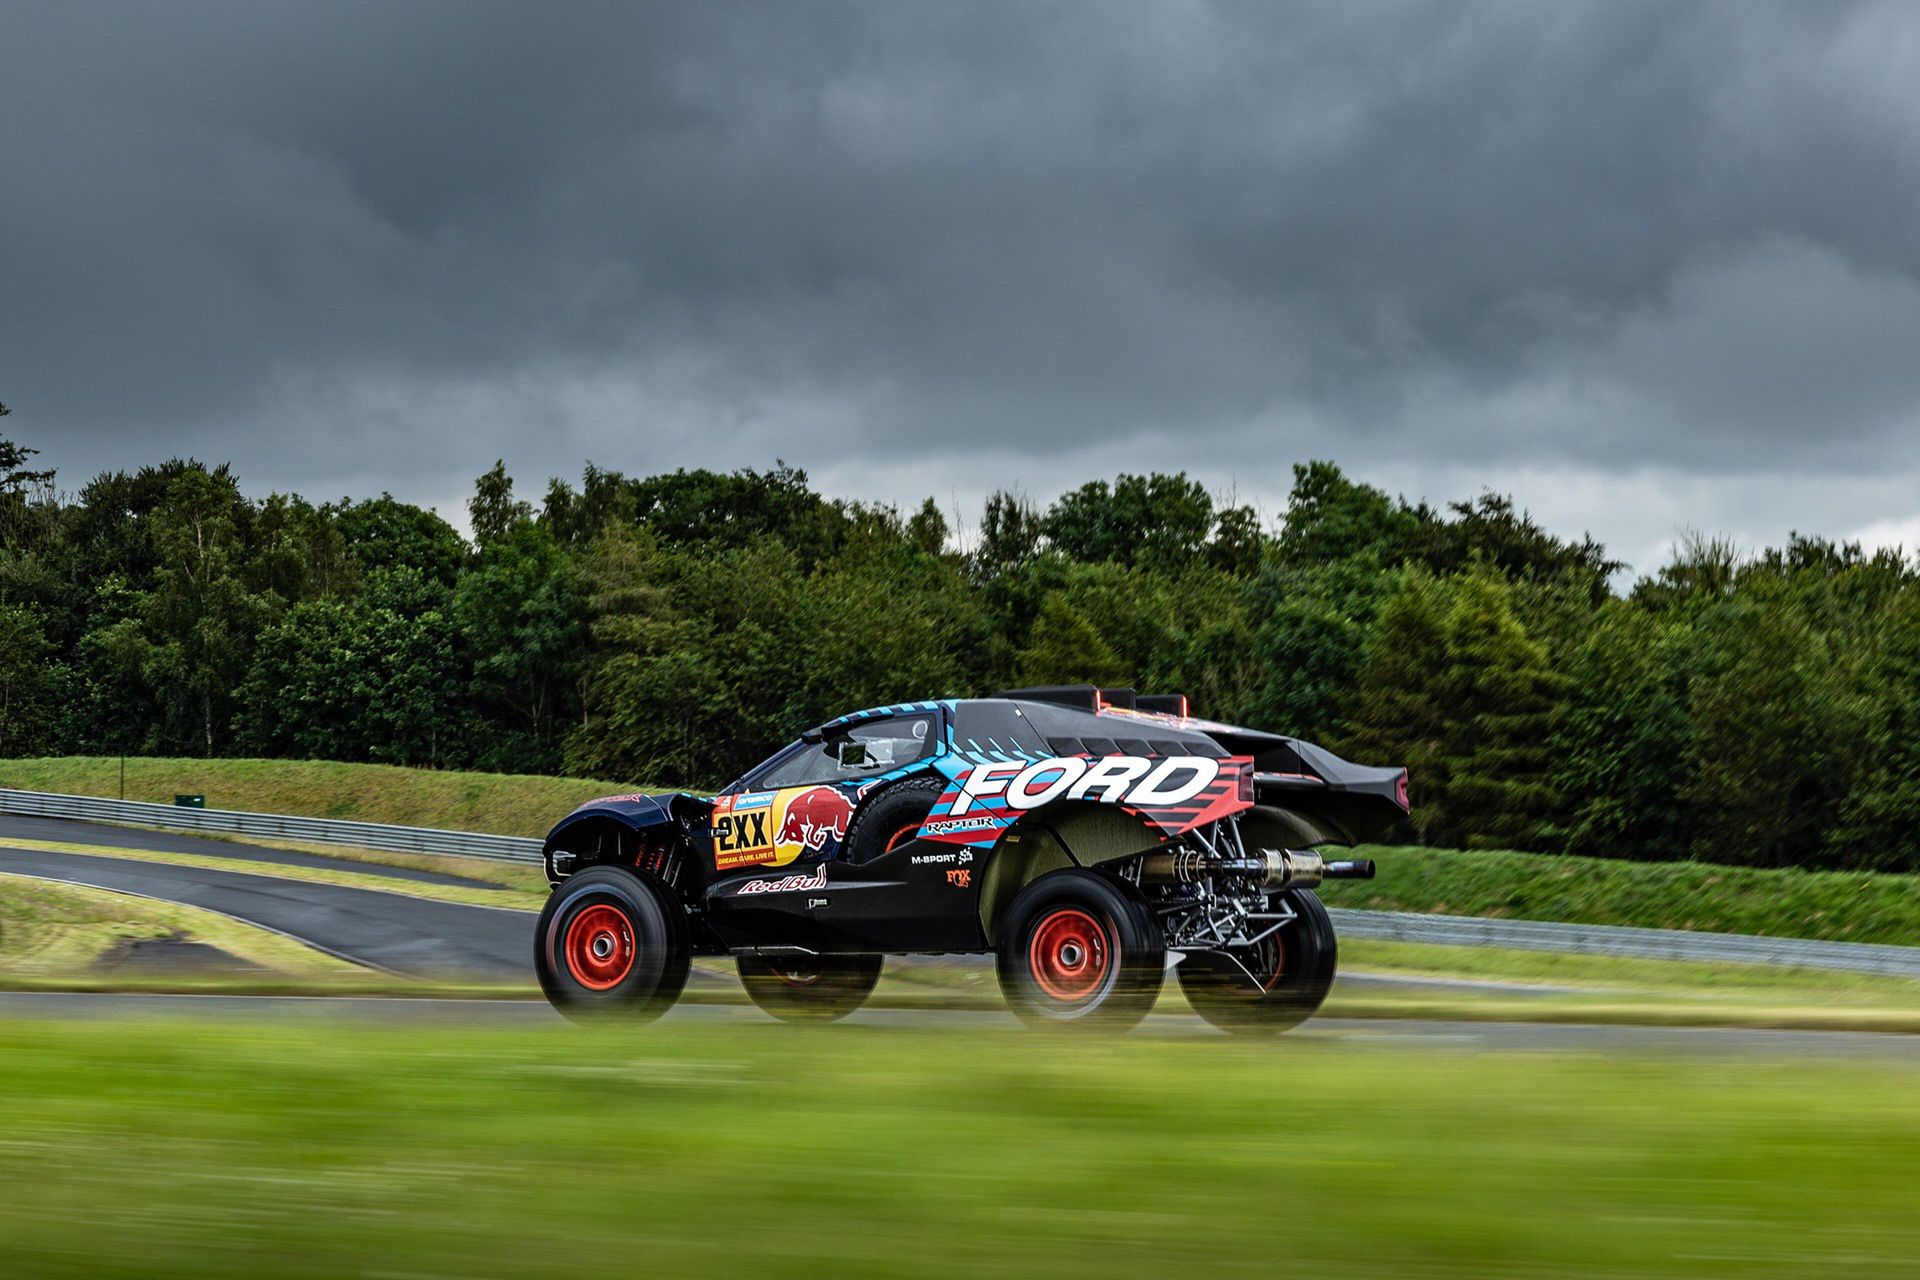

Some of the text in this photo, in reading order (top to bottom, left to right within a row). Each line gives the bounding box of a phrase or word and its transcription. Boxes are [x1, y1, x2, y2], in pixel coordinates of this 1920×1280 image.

[949, 756, 1219, 816] FORD
[718, 812, 768, 851] 2XX
[927, 816, 997, 835] RAPTOR
[911, 854, 957, 865] M-SPORT
[737, 862, 827, 894] Red Bull
[946, 869, 972, 888] FOX
